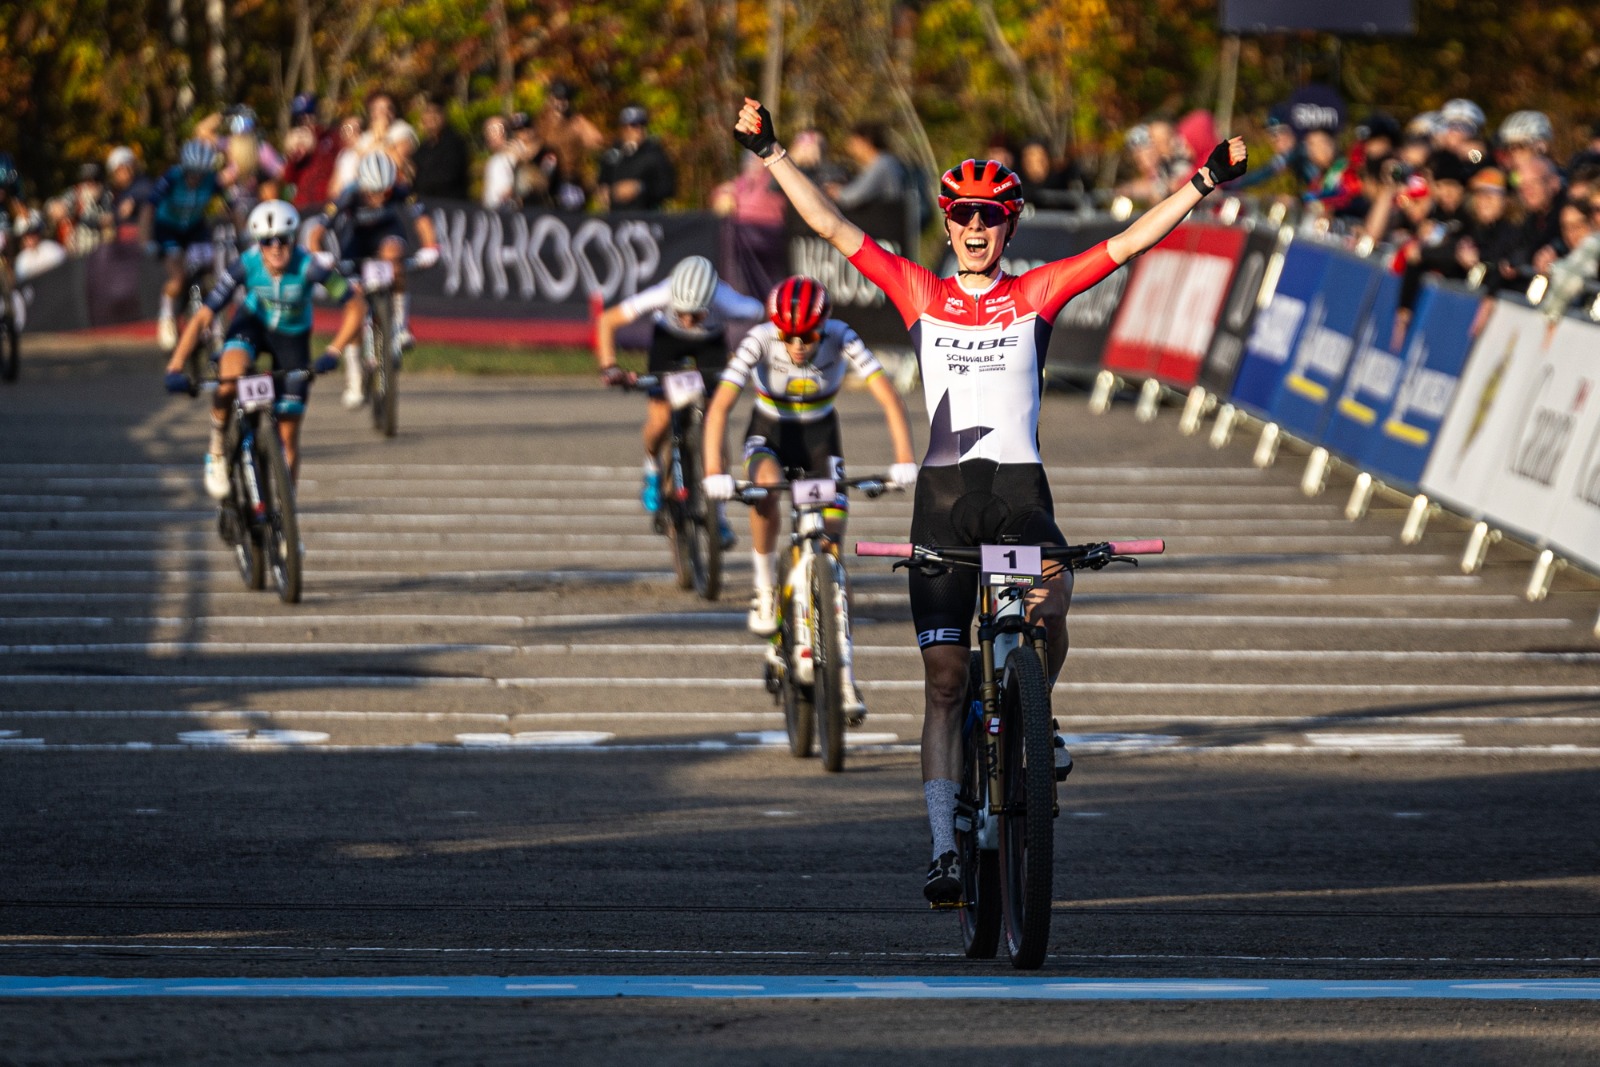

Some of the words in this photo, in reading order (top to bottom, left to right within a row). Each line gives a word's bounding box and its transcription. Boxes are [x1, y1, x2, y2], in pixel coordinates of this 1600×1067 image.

[433, 207, 660, 303] WHOOP
[934, 335, 1019, 350] CUBE
[946, 353, 995, 363] SCHWALBE
[948, 363, 971, 374] FOX
[244, 380, 270, 397] 10
[808, 482, 821, 500] 4
[1003, 549, 1017, 569] 1
